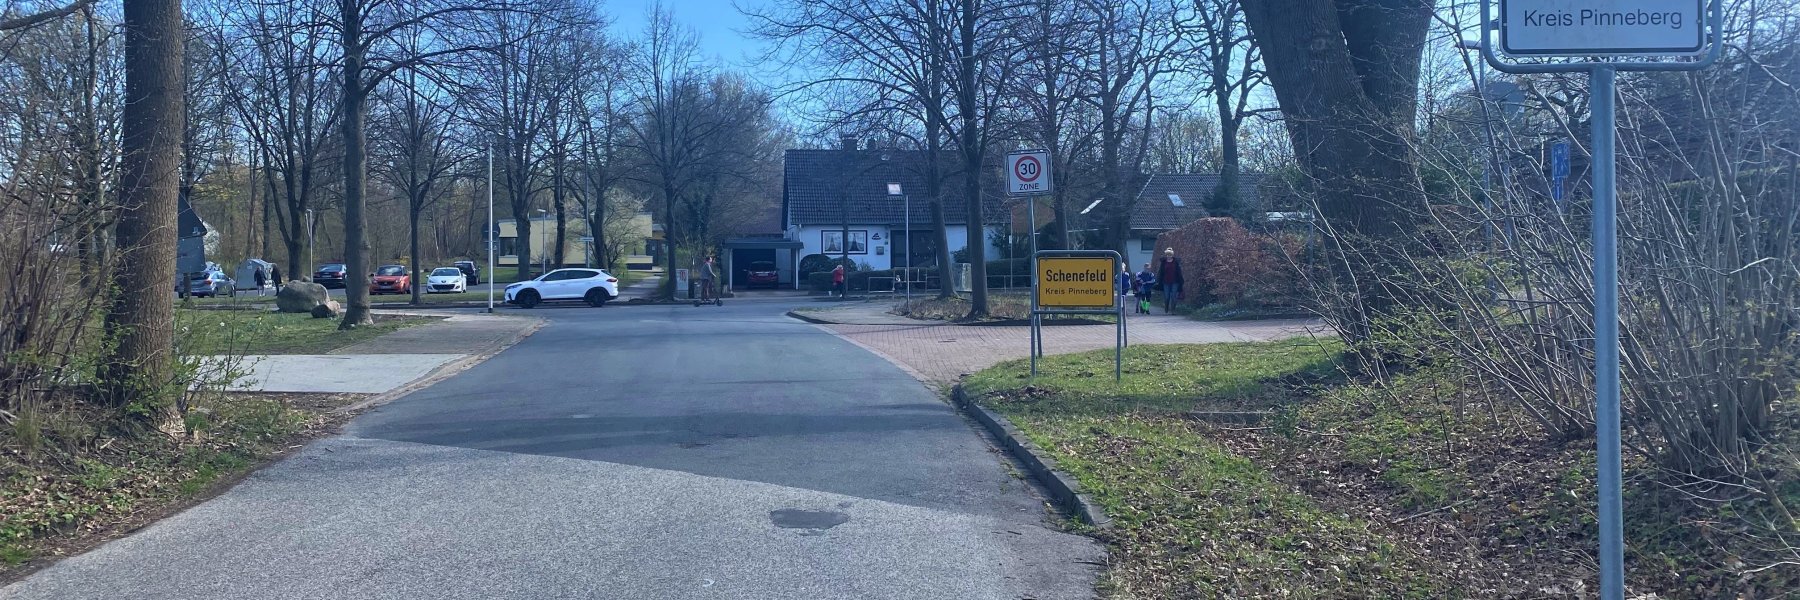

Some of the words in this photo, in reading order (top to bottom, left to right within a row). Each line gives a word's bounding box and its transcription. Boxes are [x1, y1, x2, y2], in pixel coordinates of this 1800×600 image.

[1524, 10, 1573, 27] Kreis
[1580, 9, 1682, 29] Pinneberg
[1020, 162, 1036, 175] 30
[1019, 183, 1040, 191] ZONE
[1045, 268, 1107, 282] Schenefeld
[1045, 287, 1066, 295] Kreis
[1068, 287, 1107, 296] Pinneberg
